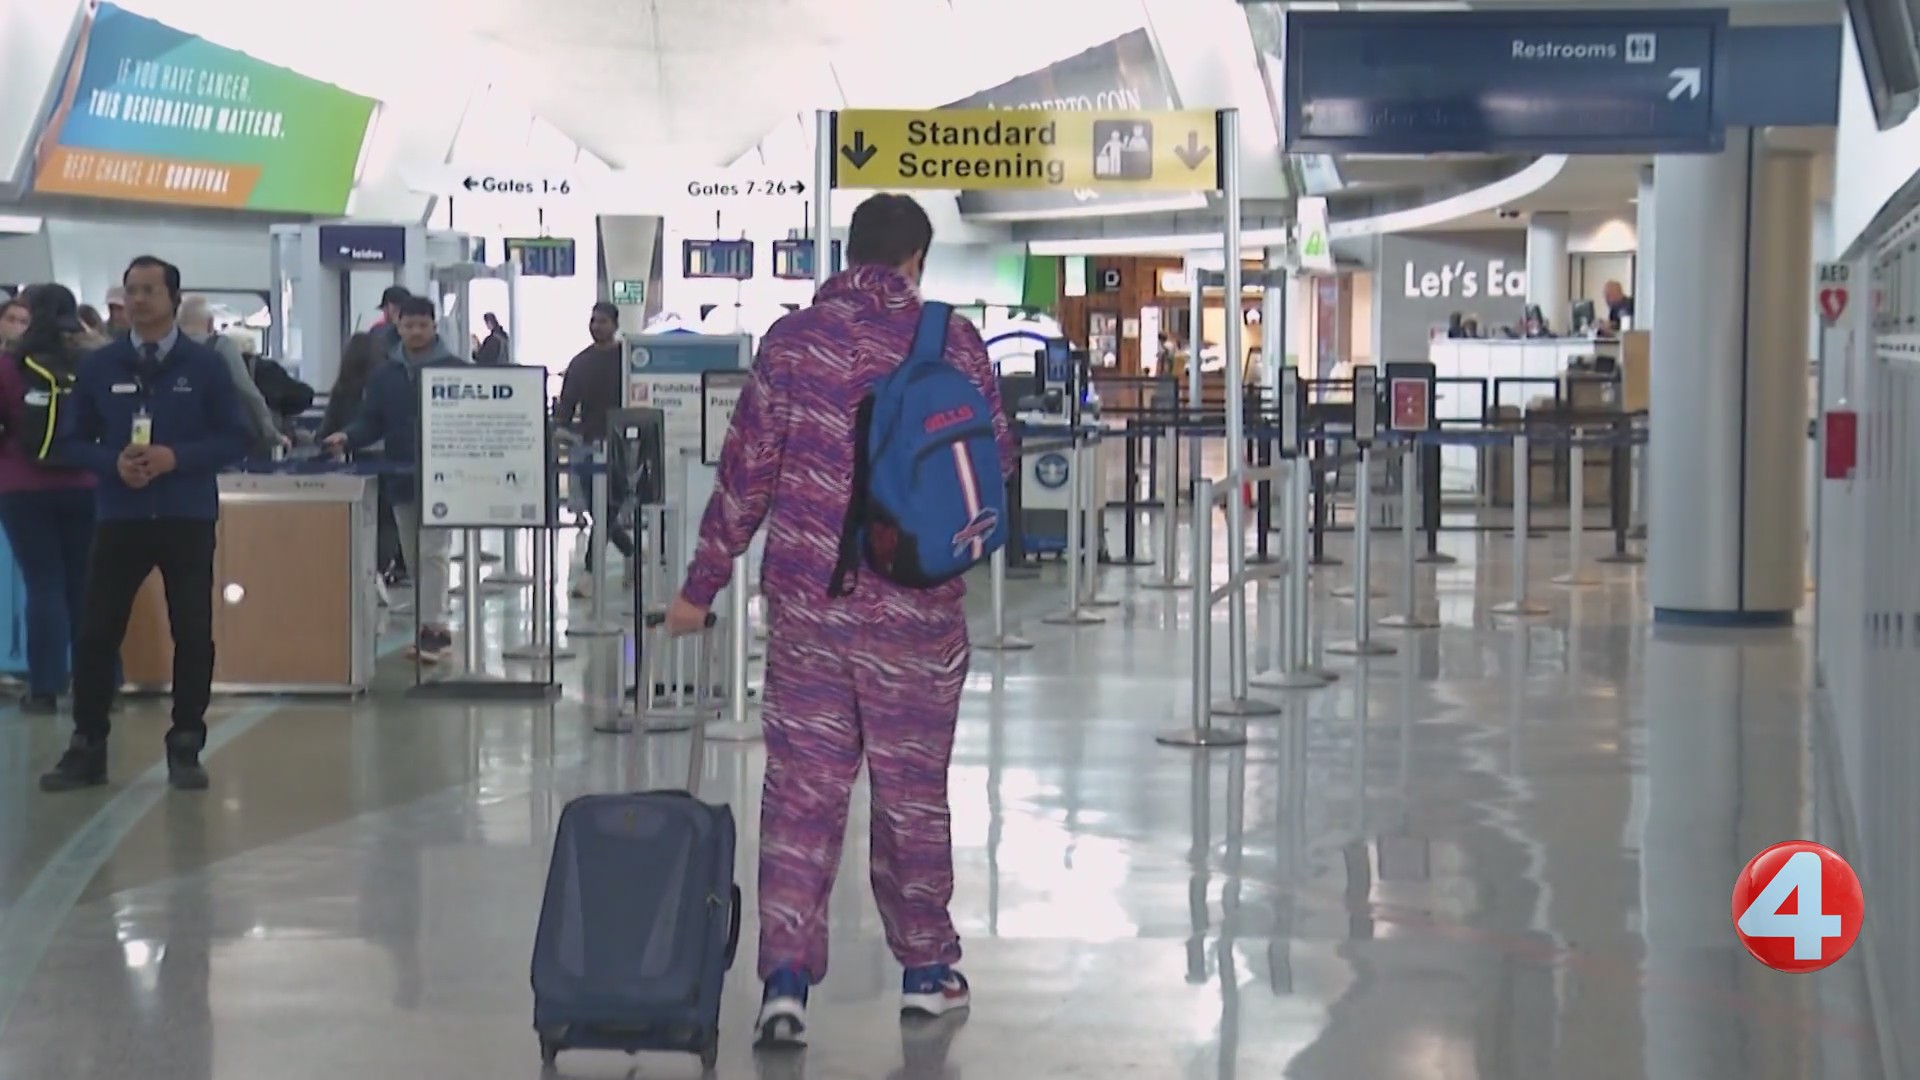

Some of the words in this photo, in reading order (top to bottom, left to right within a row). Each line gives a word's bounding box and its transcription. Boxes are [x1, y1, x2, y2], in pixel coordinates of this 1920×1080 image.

[1512, 40, 1617, 59] Restrooms
[116, 57, 131, 84] IF
[134, 59, 160, 88] YOU
[161, 64, 195, 95] HAVE
[1096, 88, 1142, 112] COIN
[88, 88, 121, 119] THIS
[122, 93, 214, 131] DESIGNATION
[215, 106, 285, 138] MATTERS.
[908, 120, 1057, 147] Standard
[63, 153, 94, 180] BEST
[96, 157, 144, 186] CHANCE
[146, 162, 163, 187] AT
[164, 164, 230, 193] SURVIVAL
[899, 152, 1066, 184] Screening
[482, 176, 534, 193] Gates
[543, 179, 571, 195] 1-6
[687, 181, 739, 197] Gates
[746, 180, 787, 196] 7-26
[1404, 260, 1478, 298] Let's
[1487, 259, 1527, 297] Ea
[1819, 264, 1849, 282] AED
[432, 384, 489, 400] REAL
[492, 384, 514, 400] ID
[653, 383, 701, 394] Prohibite
